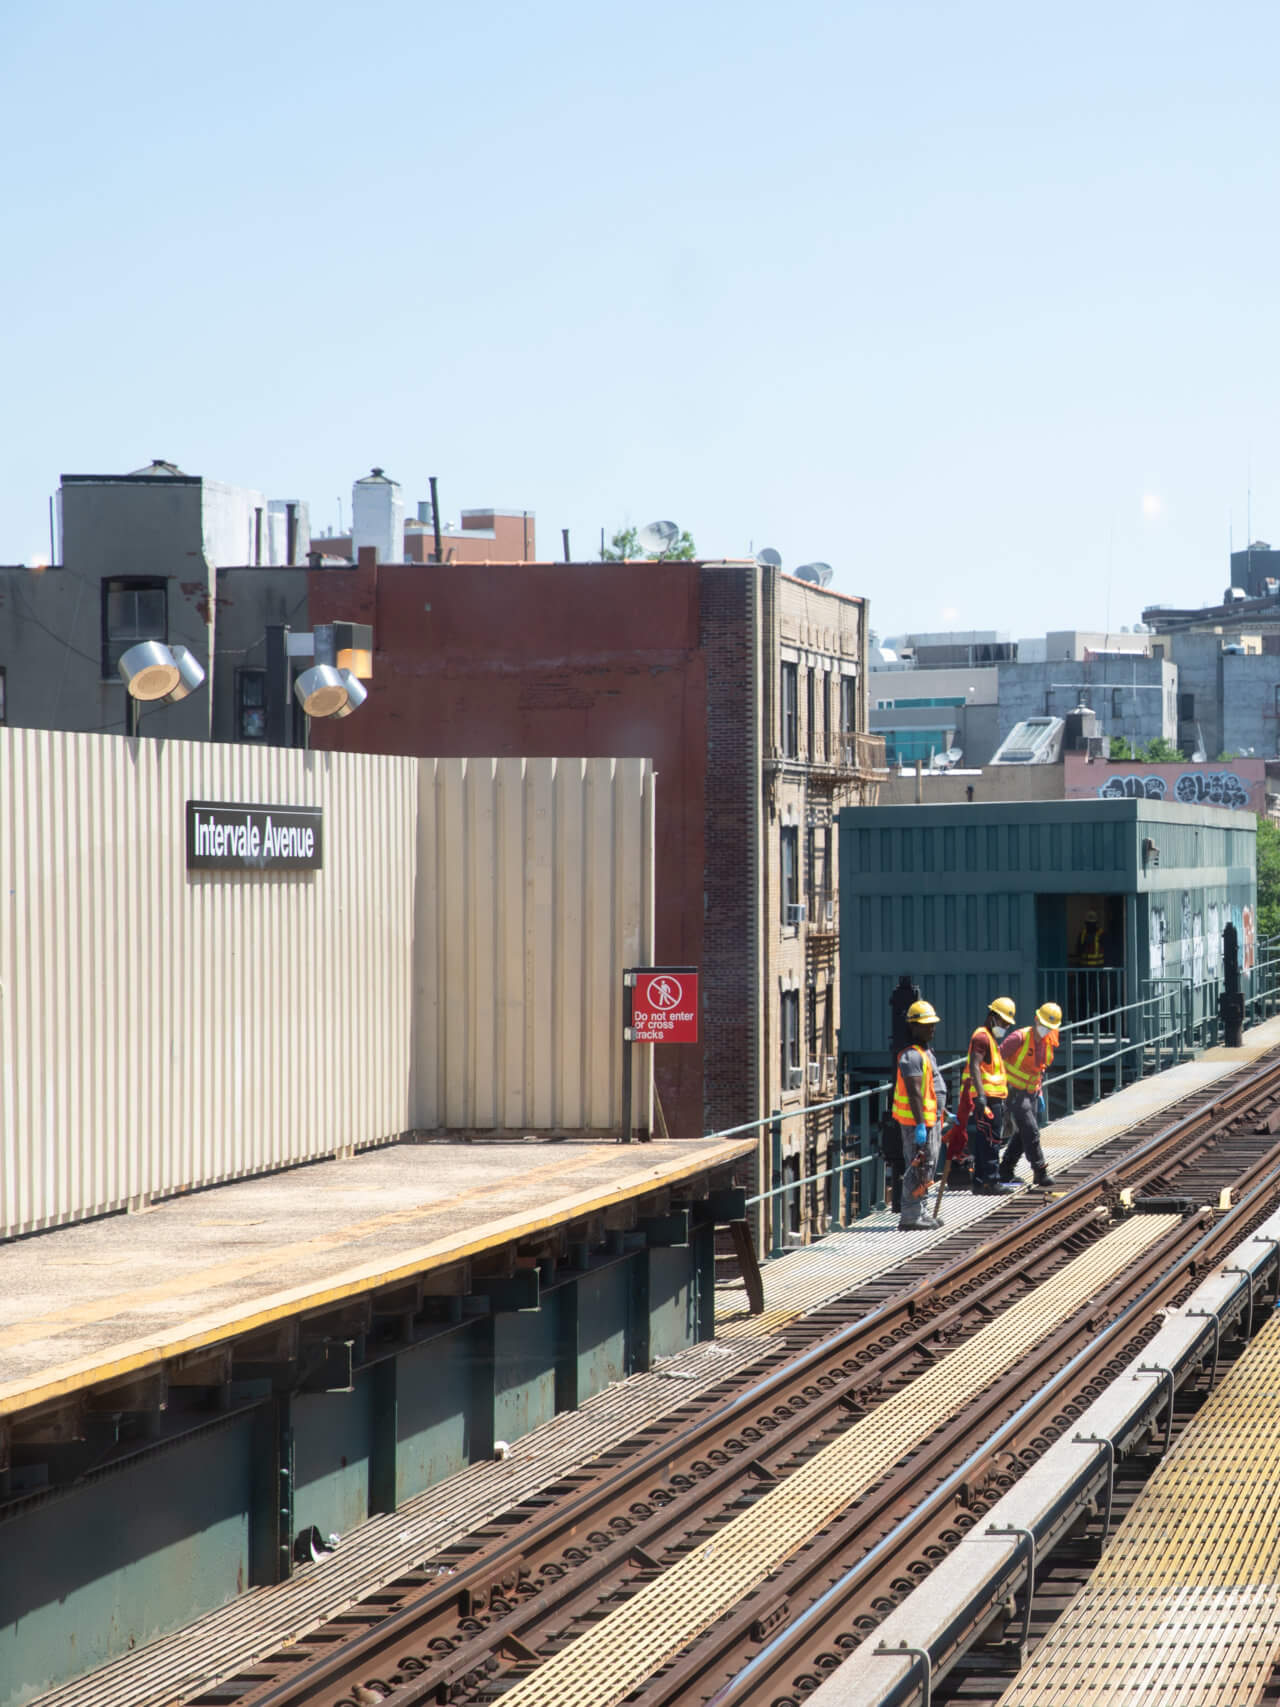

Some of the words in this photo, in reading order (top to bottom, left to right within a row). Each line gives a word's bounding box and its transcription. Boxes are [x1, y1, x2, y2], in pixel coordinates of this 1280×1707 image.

[194, 813, 260, 856] Intervale
[263, 816, 315, 858] Avenue
[634, 1011, 648, 1021] Do
[650, 1012, 666, 1021] not
[669, 1012, 694, 1021] enter
[634, 1021, 645, 1029] or
[647, 1021, 674, 1029] cross
